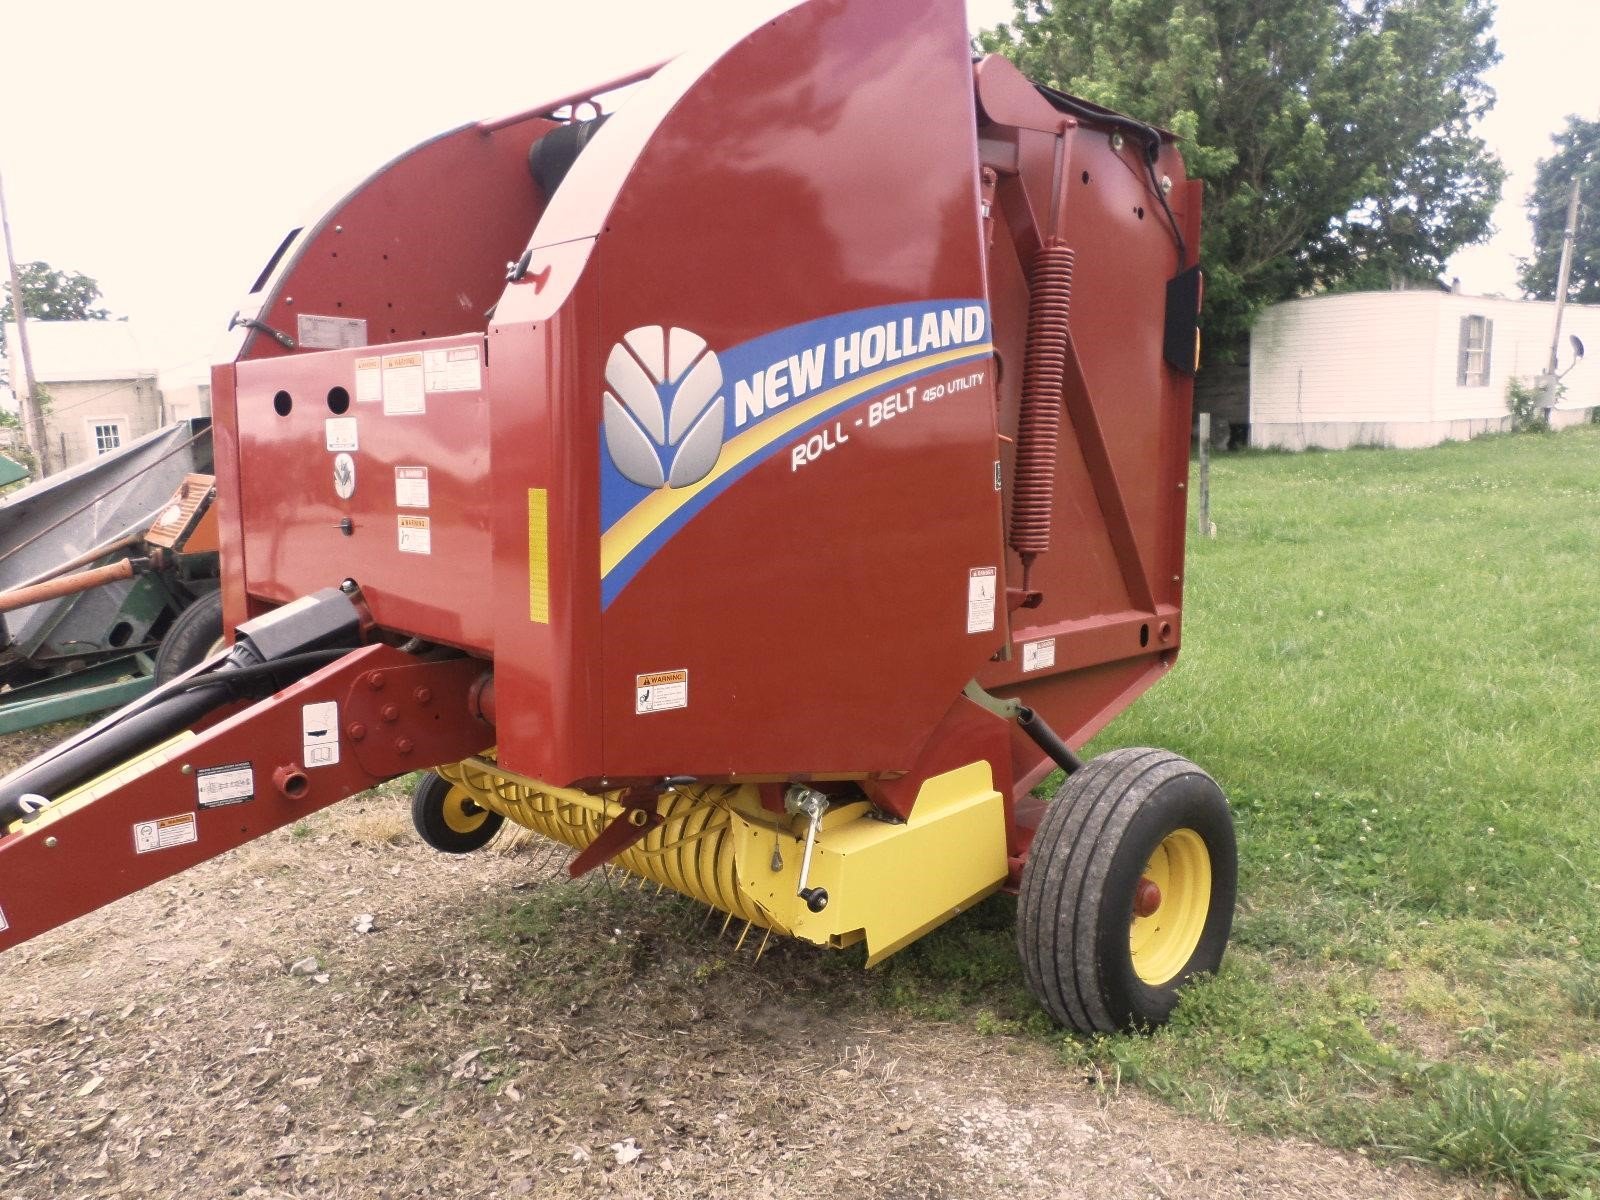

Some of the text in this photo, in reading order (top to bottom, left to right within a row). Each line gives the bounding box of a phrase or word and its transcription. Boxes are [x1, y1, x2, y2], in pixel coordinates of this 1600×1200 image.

[735, 305, 985, 427] NEW HOLLAND
[791, 422, 849, 472] ROLL
[868, 386, 917, 428] BELT
[922, 384, 945, 402] 450
[947, 372, 985, 394] UTILITY
[651, 673, 682, 684] WARNING
